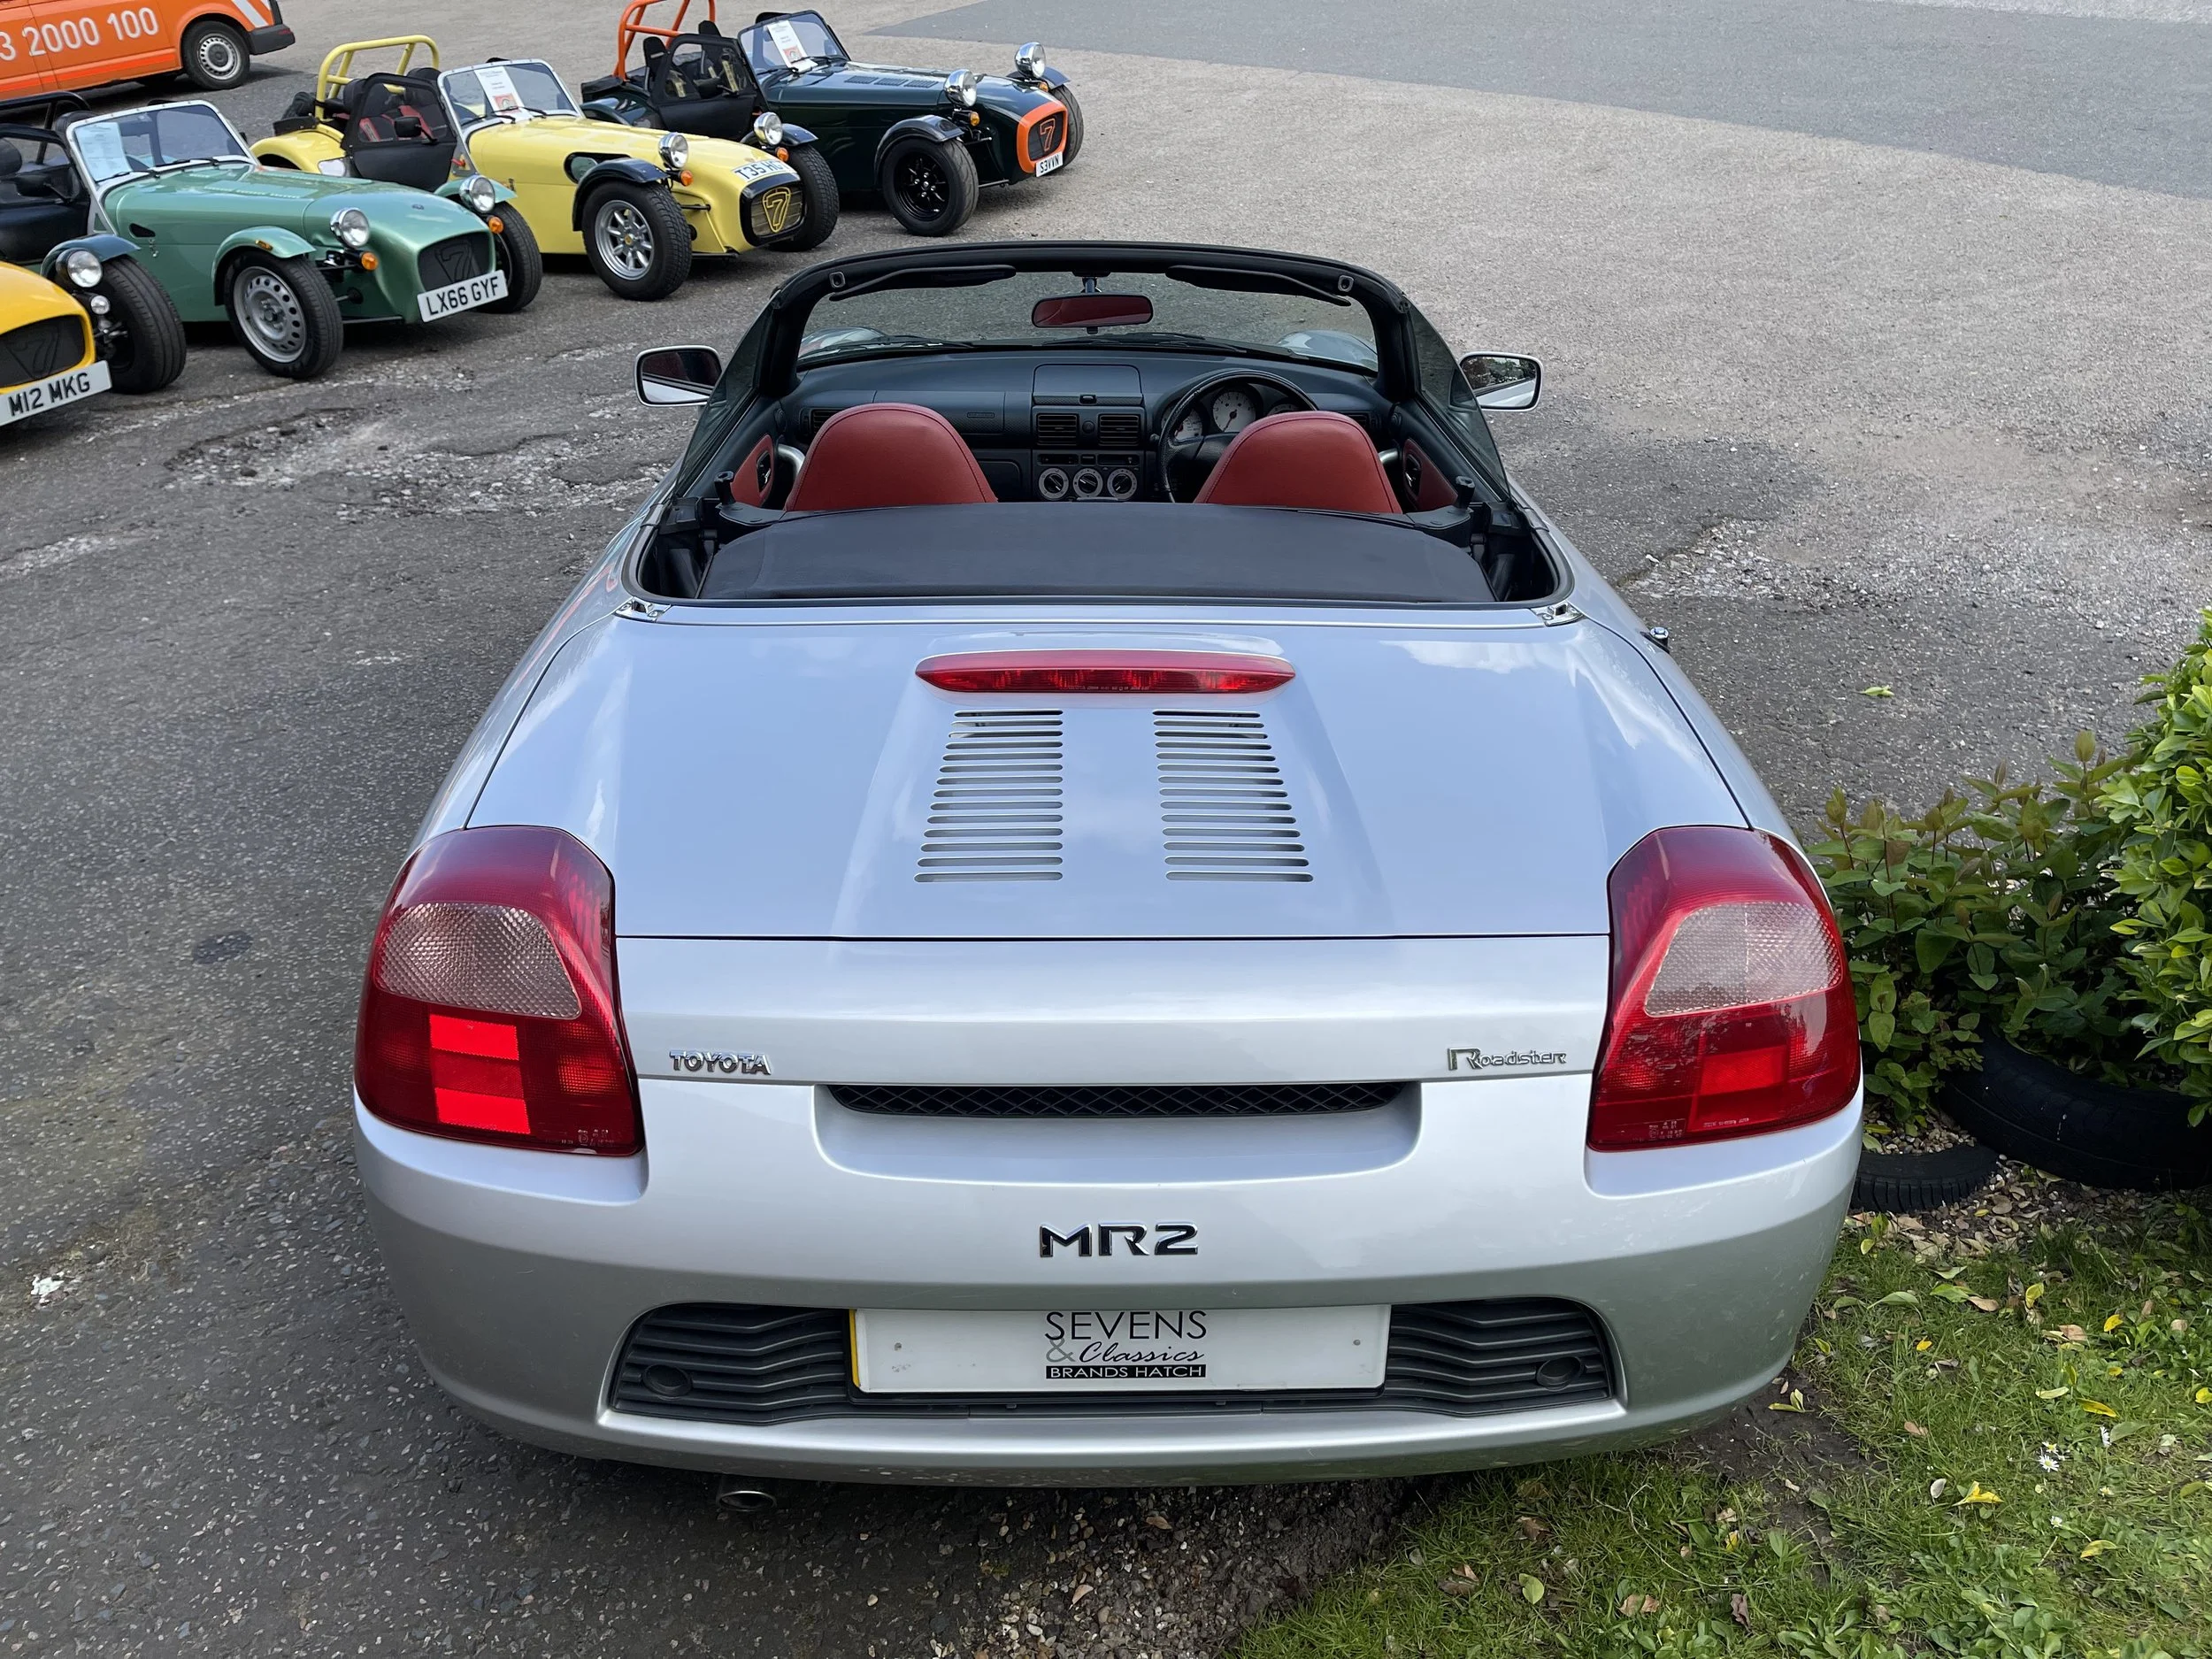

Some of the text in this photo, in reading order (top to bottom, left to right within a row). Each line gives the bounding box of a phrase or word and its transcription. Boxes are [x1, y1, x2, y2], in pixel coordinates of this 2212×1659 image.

[22, 17, 100, 57] 2000
[107, 7, 158, 41] 100
[1040, 118, 1056, 152] 7
[734, 163, 766, 180] T35
[766, 191, 788, 227] 7
[426, 276, 498, 316] LX66 GYF
[8, 373, 90, 417] M12 MKG
[669, 1049, 772, 1075] TOYOTA
[1448, 1048, 1567, 1071] Roadster
[1040, 1221, 1198, 1257] MR2
[1044, 1310, 1207, 1340] SEVENS
[1045, 1338, 1204, 1363] & Classics
[1050, 1365, 1202, 1379] BRANDS HATCH
